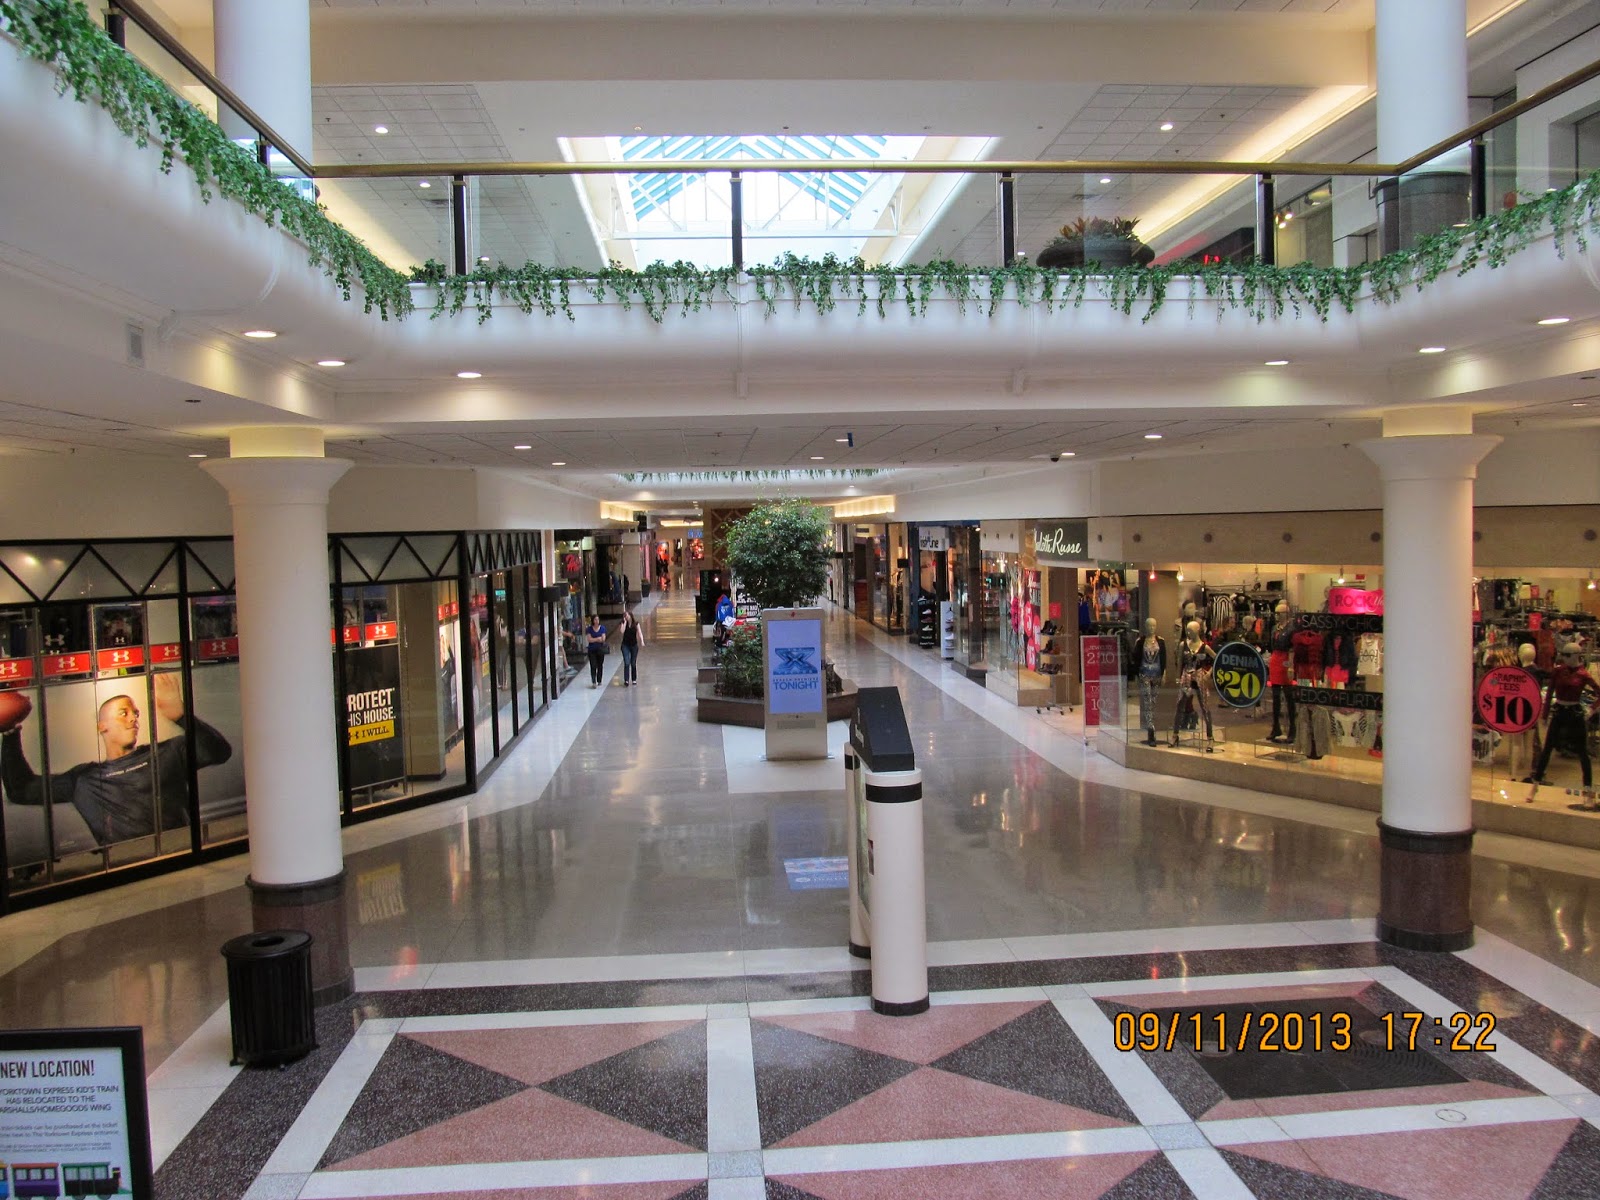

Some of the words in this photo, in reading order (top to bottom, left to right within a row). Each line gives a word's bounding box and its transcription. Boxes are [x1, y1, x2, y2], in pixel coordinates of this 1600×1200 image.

[1334, 594, 1373, 608] ROCK
[1301, 614, 1340, 629] SASSY
[1346, 617, 1379, 632] CHIC
[1221, 653, 1259, 669] DENIM
[773, 681, 818, 690] TONIGHT
[1216, 669, 1261, 699] $20
[1493, 672, 1528, 684] GRAPHIC
[1499, 683, 1520, 692] TEES
[347, 687, 394, 712] ROTECT
[1301, 688, 1335, 704] EDGY
[1339, 692, 1380, 708] FLIRTY
[347, 711, 362, 727] HIS
[363, 706, 397, 724] HOUSE.
[1482, 693, 1533, 726] $10
[0, 1061, 28, 1079] NEW
[32, 1059, 95, 1078] LOCATION!
[43, 1086, 74, 1095] EXPRESS
[76, 1085, 95, 1093] KID'S
[96, 1085, 119, 1093] TRAIN
[6, 1096, 21, 1105] HAS
[22, 1095, 66, 1104] RELOCATED
[68, 1095, 80, 1103] TO
[81, 1094, 96, 1103] THE
[0, 1103, 88, 1114] ARSHALLS/HOMEGOODS
[90, 1103, 112, 1112] WING
